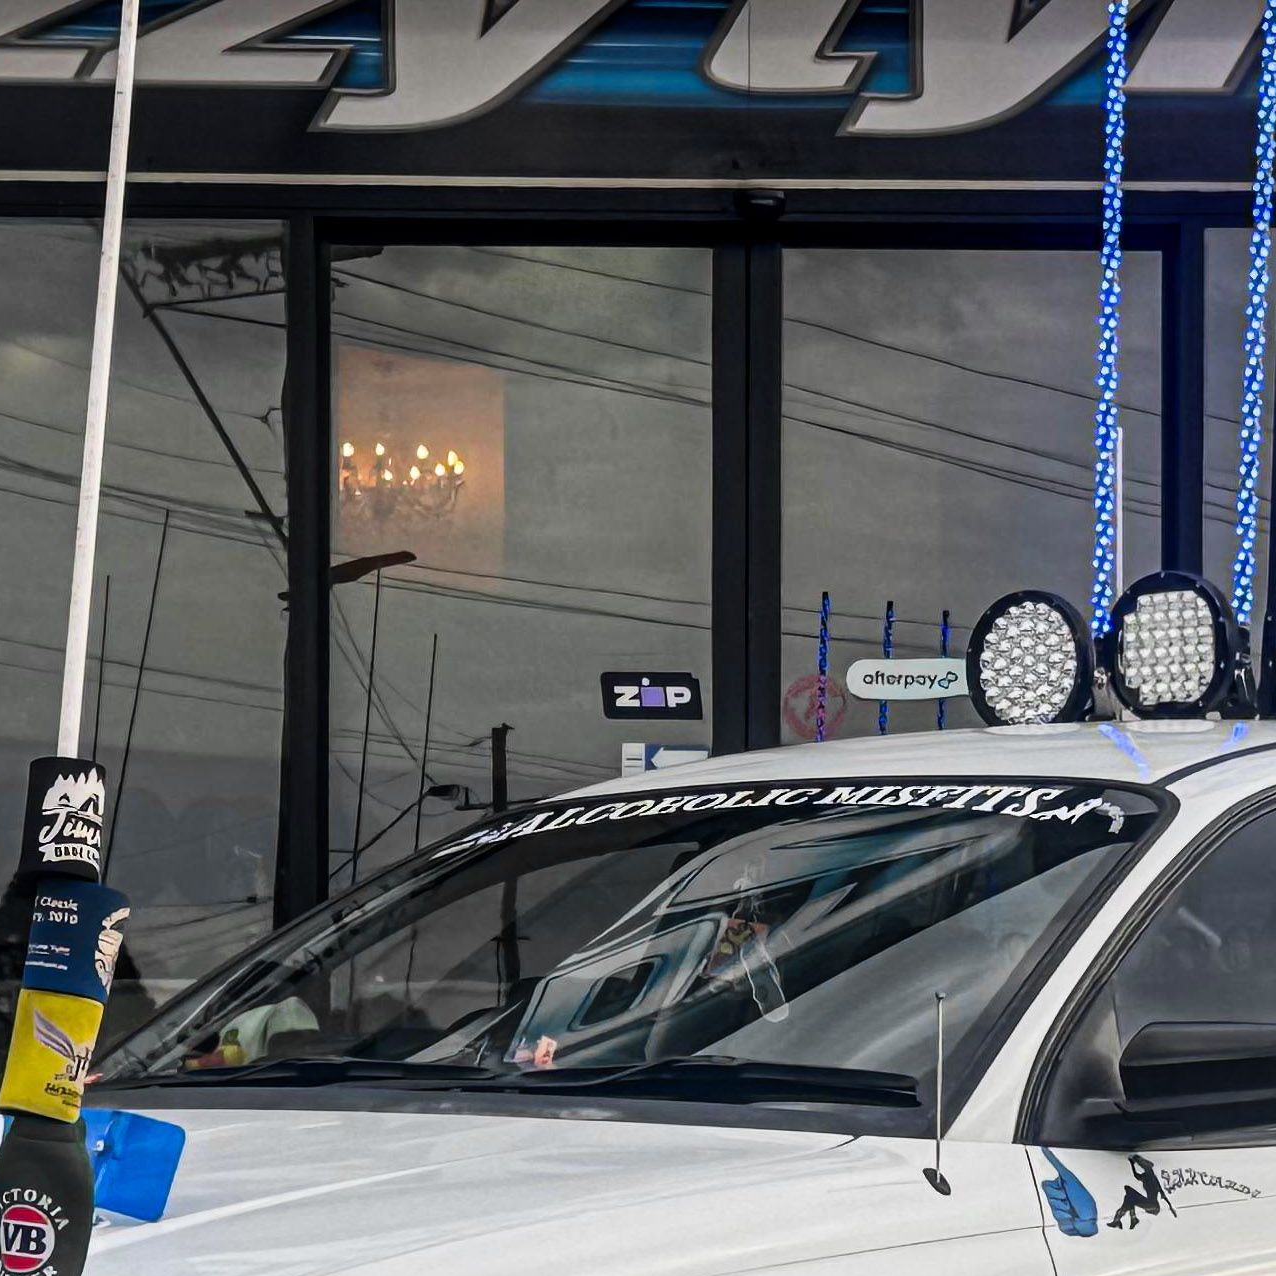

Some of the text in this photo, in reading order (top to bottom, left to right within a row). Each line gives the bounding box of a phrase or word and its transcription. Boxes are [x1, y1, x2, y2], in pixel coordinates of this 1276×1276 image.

[863, 671, 938, 691] afterpay
[822, 784, 1058, 818] MISFITS
[2, 1222, 47, 1255] VB
